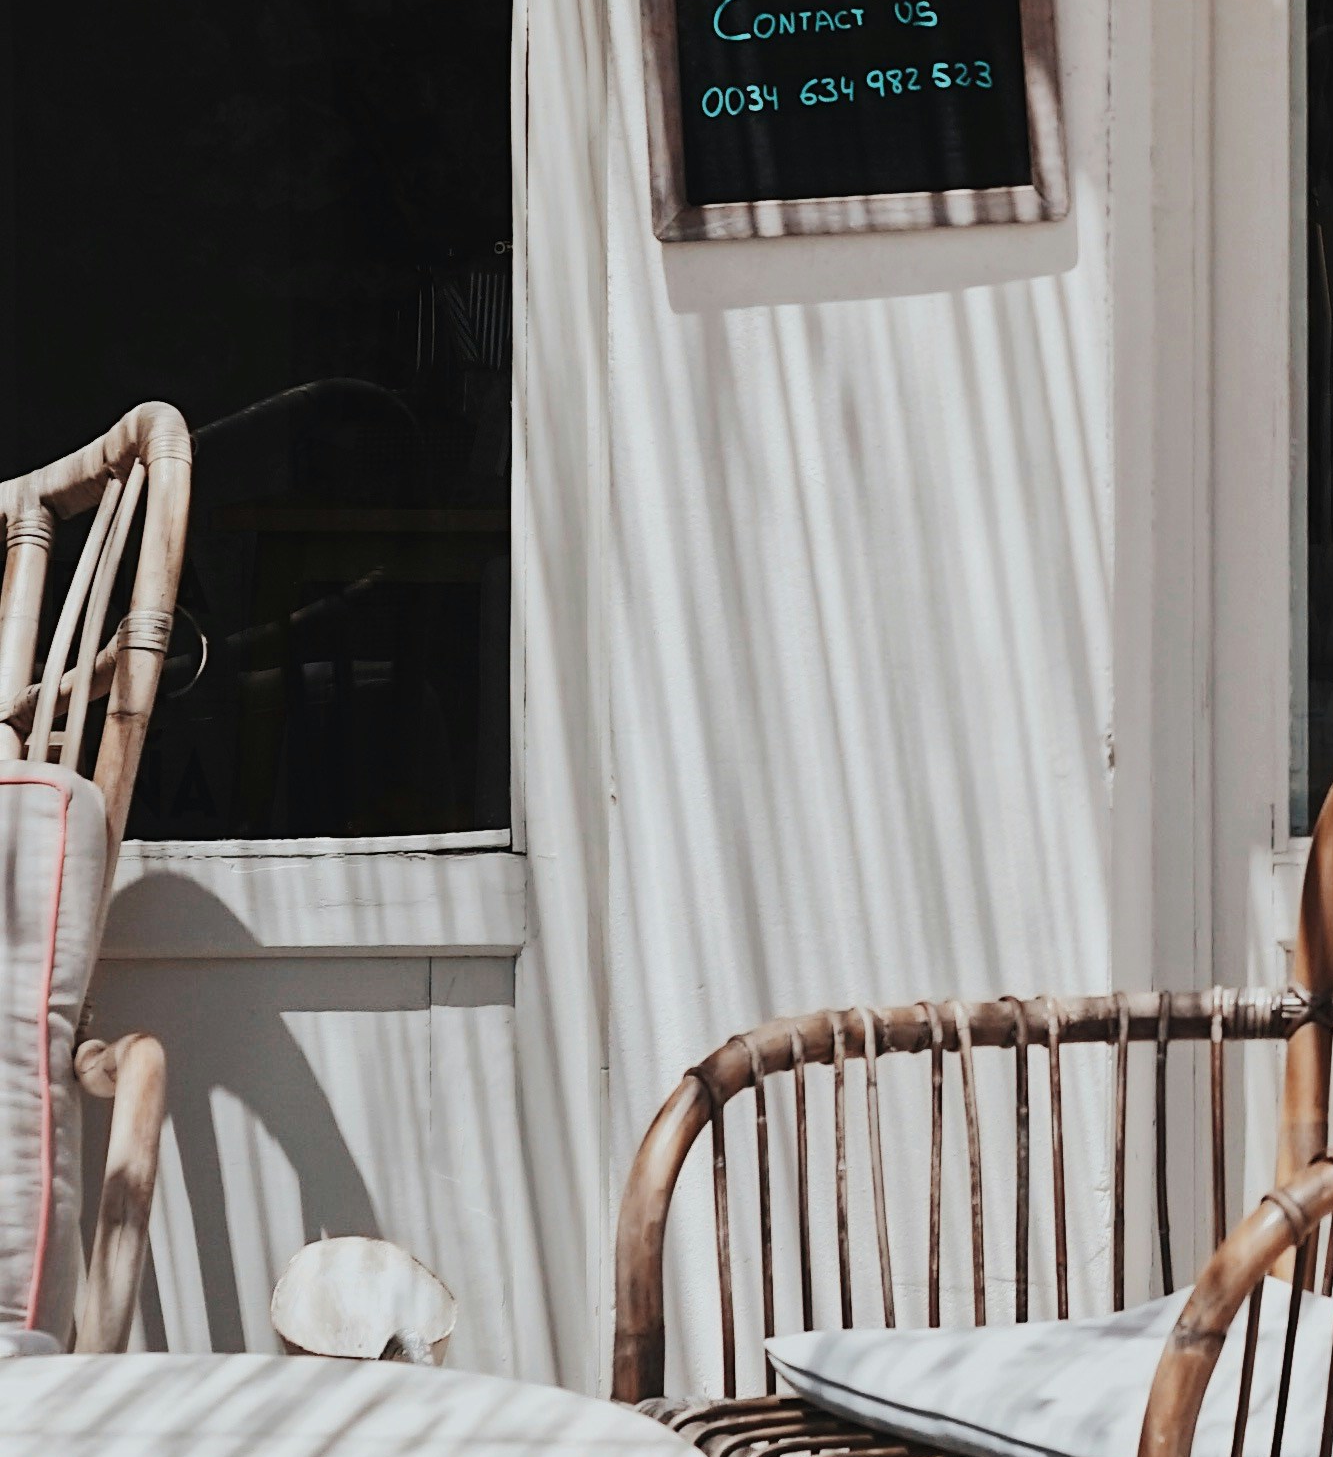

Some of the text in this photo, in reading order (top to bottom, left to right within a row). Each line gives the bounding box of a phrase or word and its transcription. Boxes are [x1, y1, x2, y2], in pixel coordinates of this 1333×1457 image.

[702, 61, 994, 118] 0034 634 982 523
